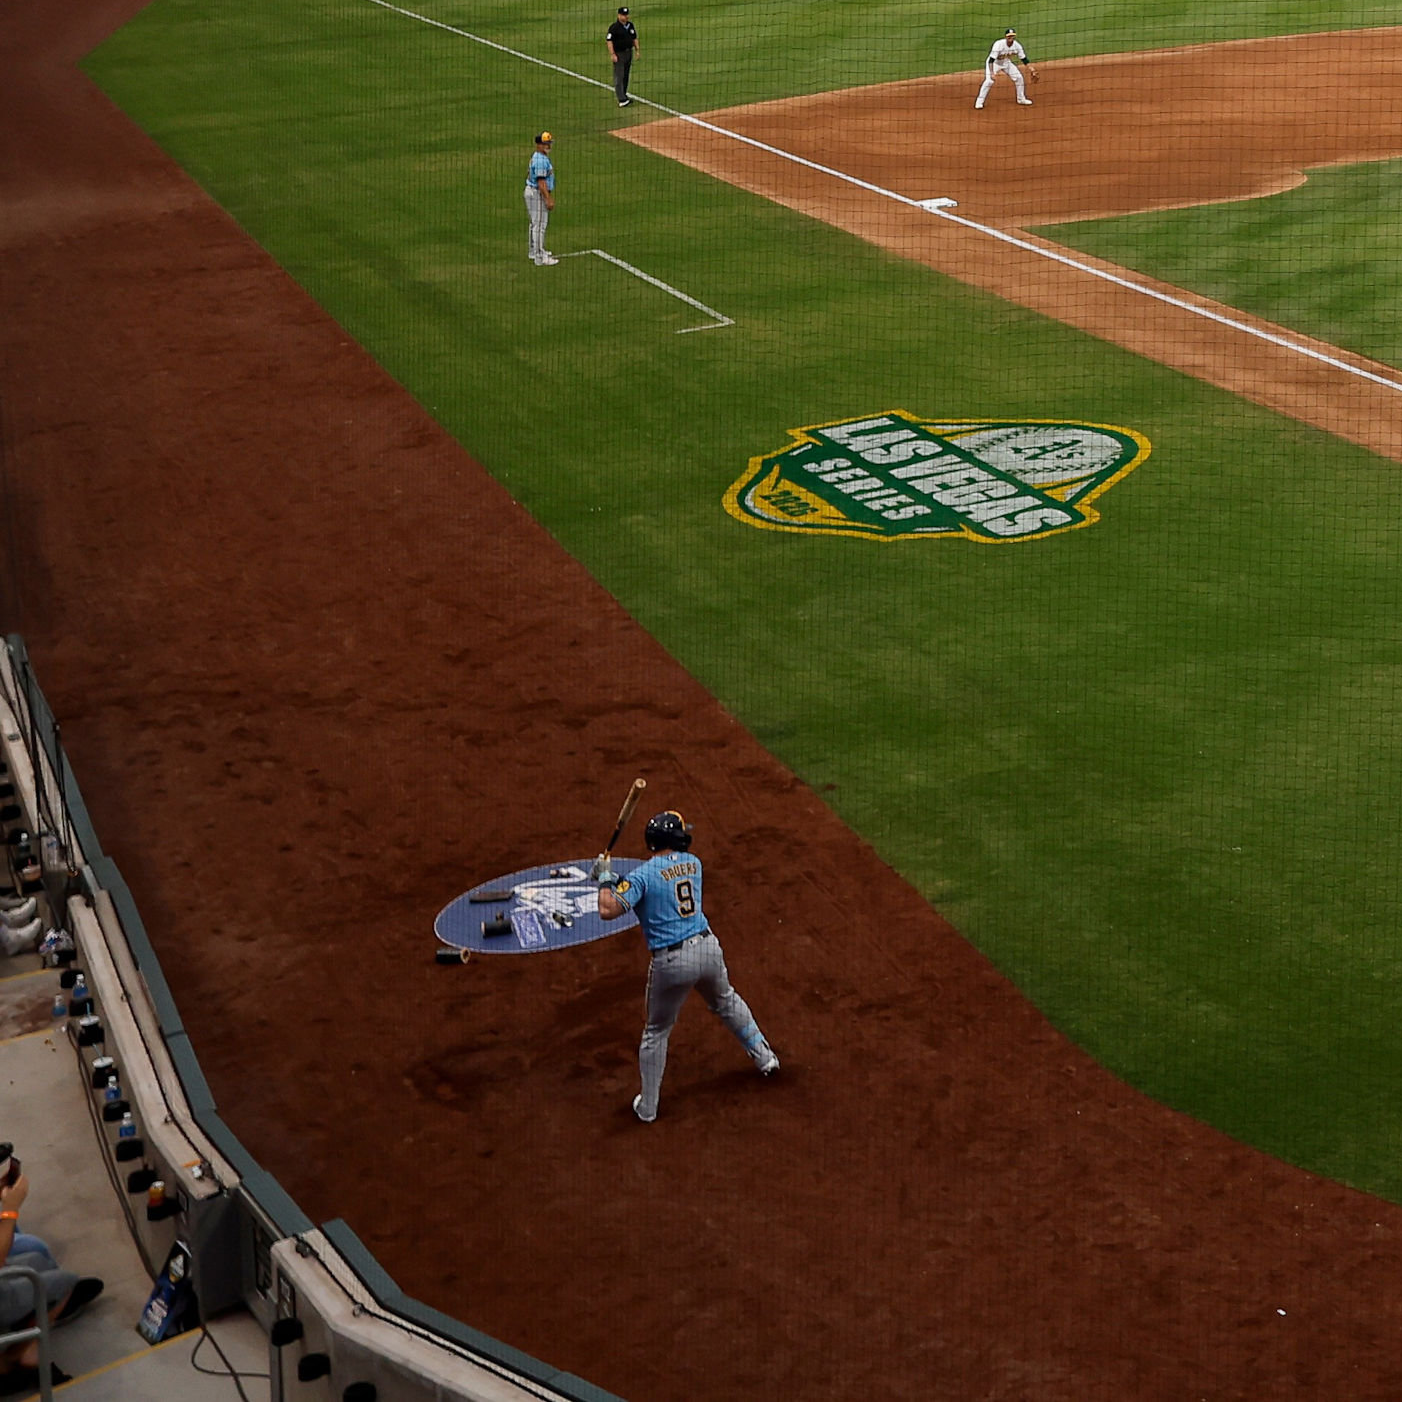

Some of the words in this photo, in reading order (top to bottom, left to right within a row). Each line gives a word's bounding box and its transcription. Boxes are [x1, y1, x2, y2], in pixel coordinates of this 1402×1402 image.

[801, 456, 934, 522] SERIES
[818, 416, 944, 466] LAS
[889, 453, 1074, 537] VEGAS
[660, 862, 697, 882] BAUERS
[674, 878, 697, 918] 9
